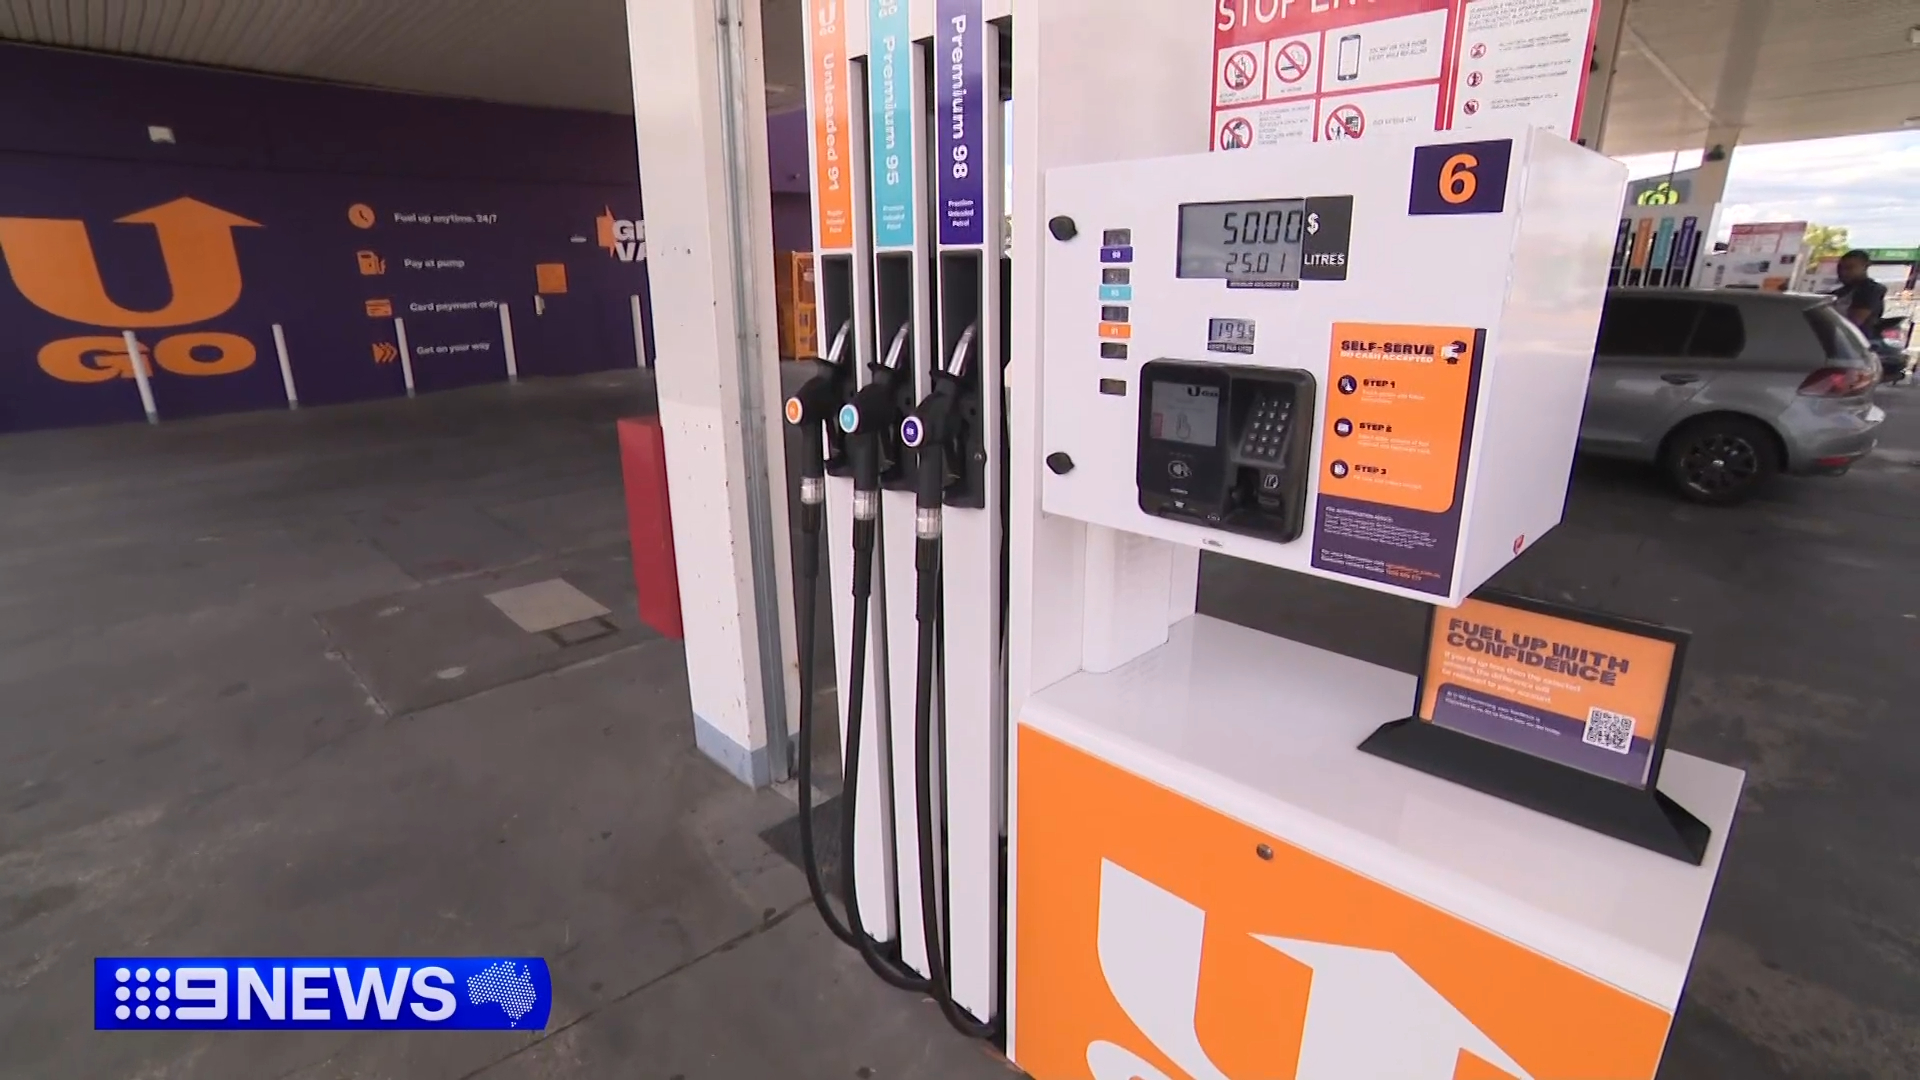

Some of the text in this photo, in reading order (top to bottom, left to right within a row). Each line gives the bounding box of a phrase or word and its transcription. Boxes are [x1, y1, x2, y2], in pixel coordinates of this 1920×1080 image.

[951, 14, 968, 179] Premium 98
[883, 35, 899, 185] Premium 95
[823, 53, 840, 191] Unleaded 91
[1438, 153, 1478, 204] 6
[394, 212, 417, 223] Fuel
[418, 215, 431, 225] up
[476, 214, 498, 225] 24/7
[1223, 210, 1303, 245] 50.00
[404, 258, 423, 269] Pay
[437, 260, 465, 269] pump
[1225, 252, 1286, 274] 25.01
[1303, 253, 1345, 265] LITRES
[410, 300, 499, 312] Card payment only
[417, 342, 491, 355] Get on your way
[1341, 340, 1435, 355] SELF-SERVE
[37, 332, 257, 382] GO
[1355, 351, 1381, 360] CASH
[1382, 353, 1434, 363] ACCEPTED
[1363, 378, 1396, 389] STEP 1
[1359, 422, 1392, 433] STEP 2
[1354, 464, 1380, 473] STEP
[1449, 618, 1629, 674] FUEL UP WITH
[1447, 631, 1618, 686] CONFIDENCE
